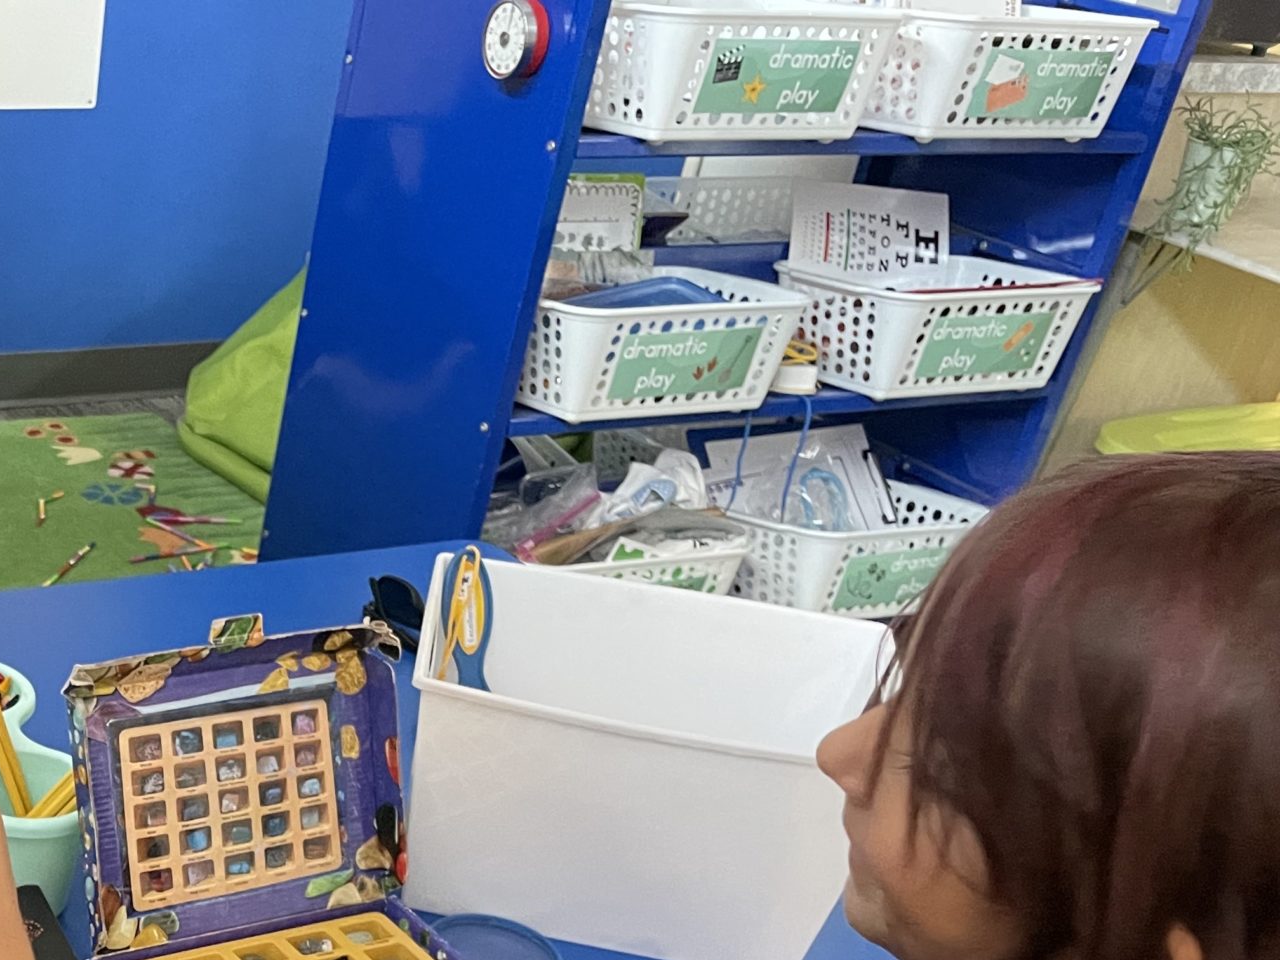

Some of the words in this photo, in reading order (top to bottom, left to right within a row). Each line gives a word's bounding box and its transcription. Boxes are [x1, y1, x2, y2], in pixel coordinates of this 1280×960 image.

[770, 43, 854, 69] dramatic
[1037, 54, 1108, 77] dramatic
[775, 80, 820, 110] play
[1039, 88, 1077, 116] play
[915, 229, 939, 264] E
[933, 319, 1008, 341] dramatic
[623, 336, 708, 360] dramatic
[938, 348, 976, 374] play
[634, 367, 676, 394] play
